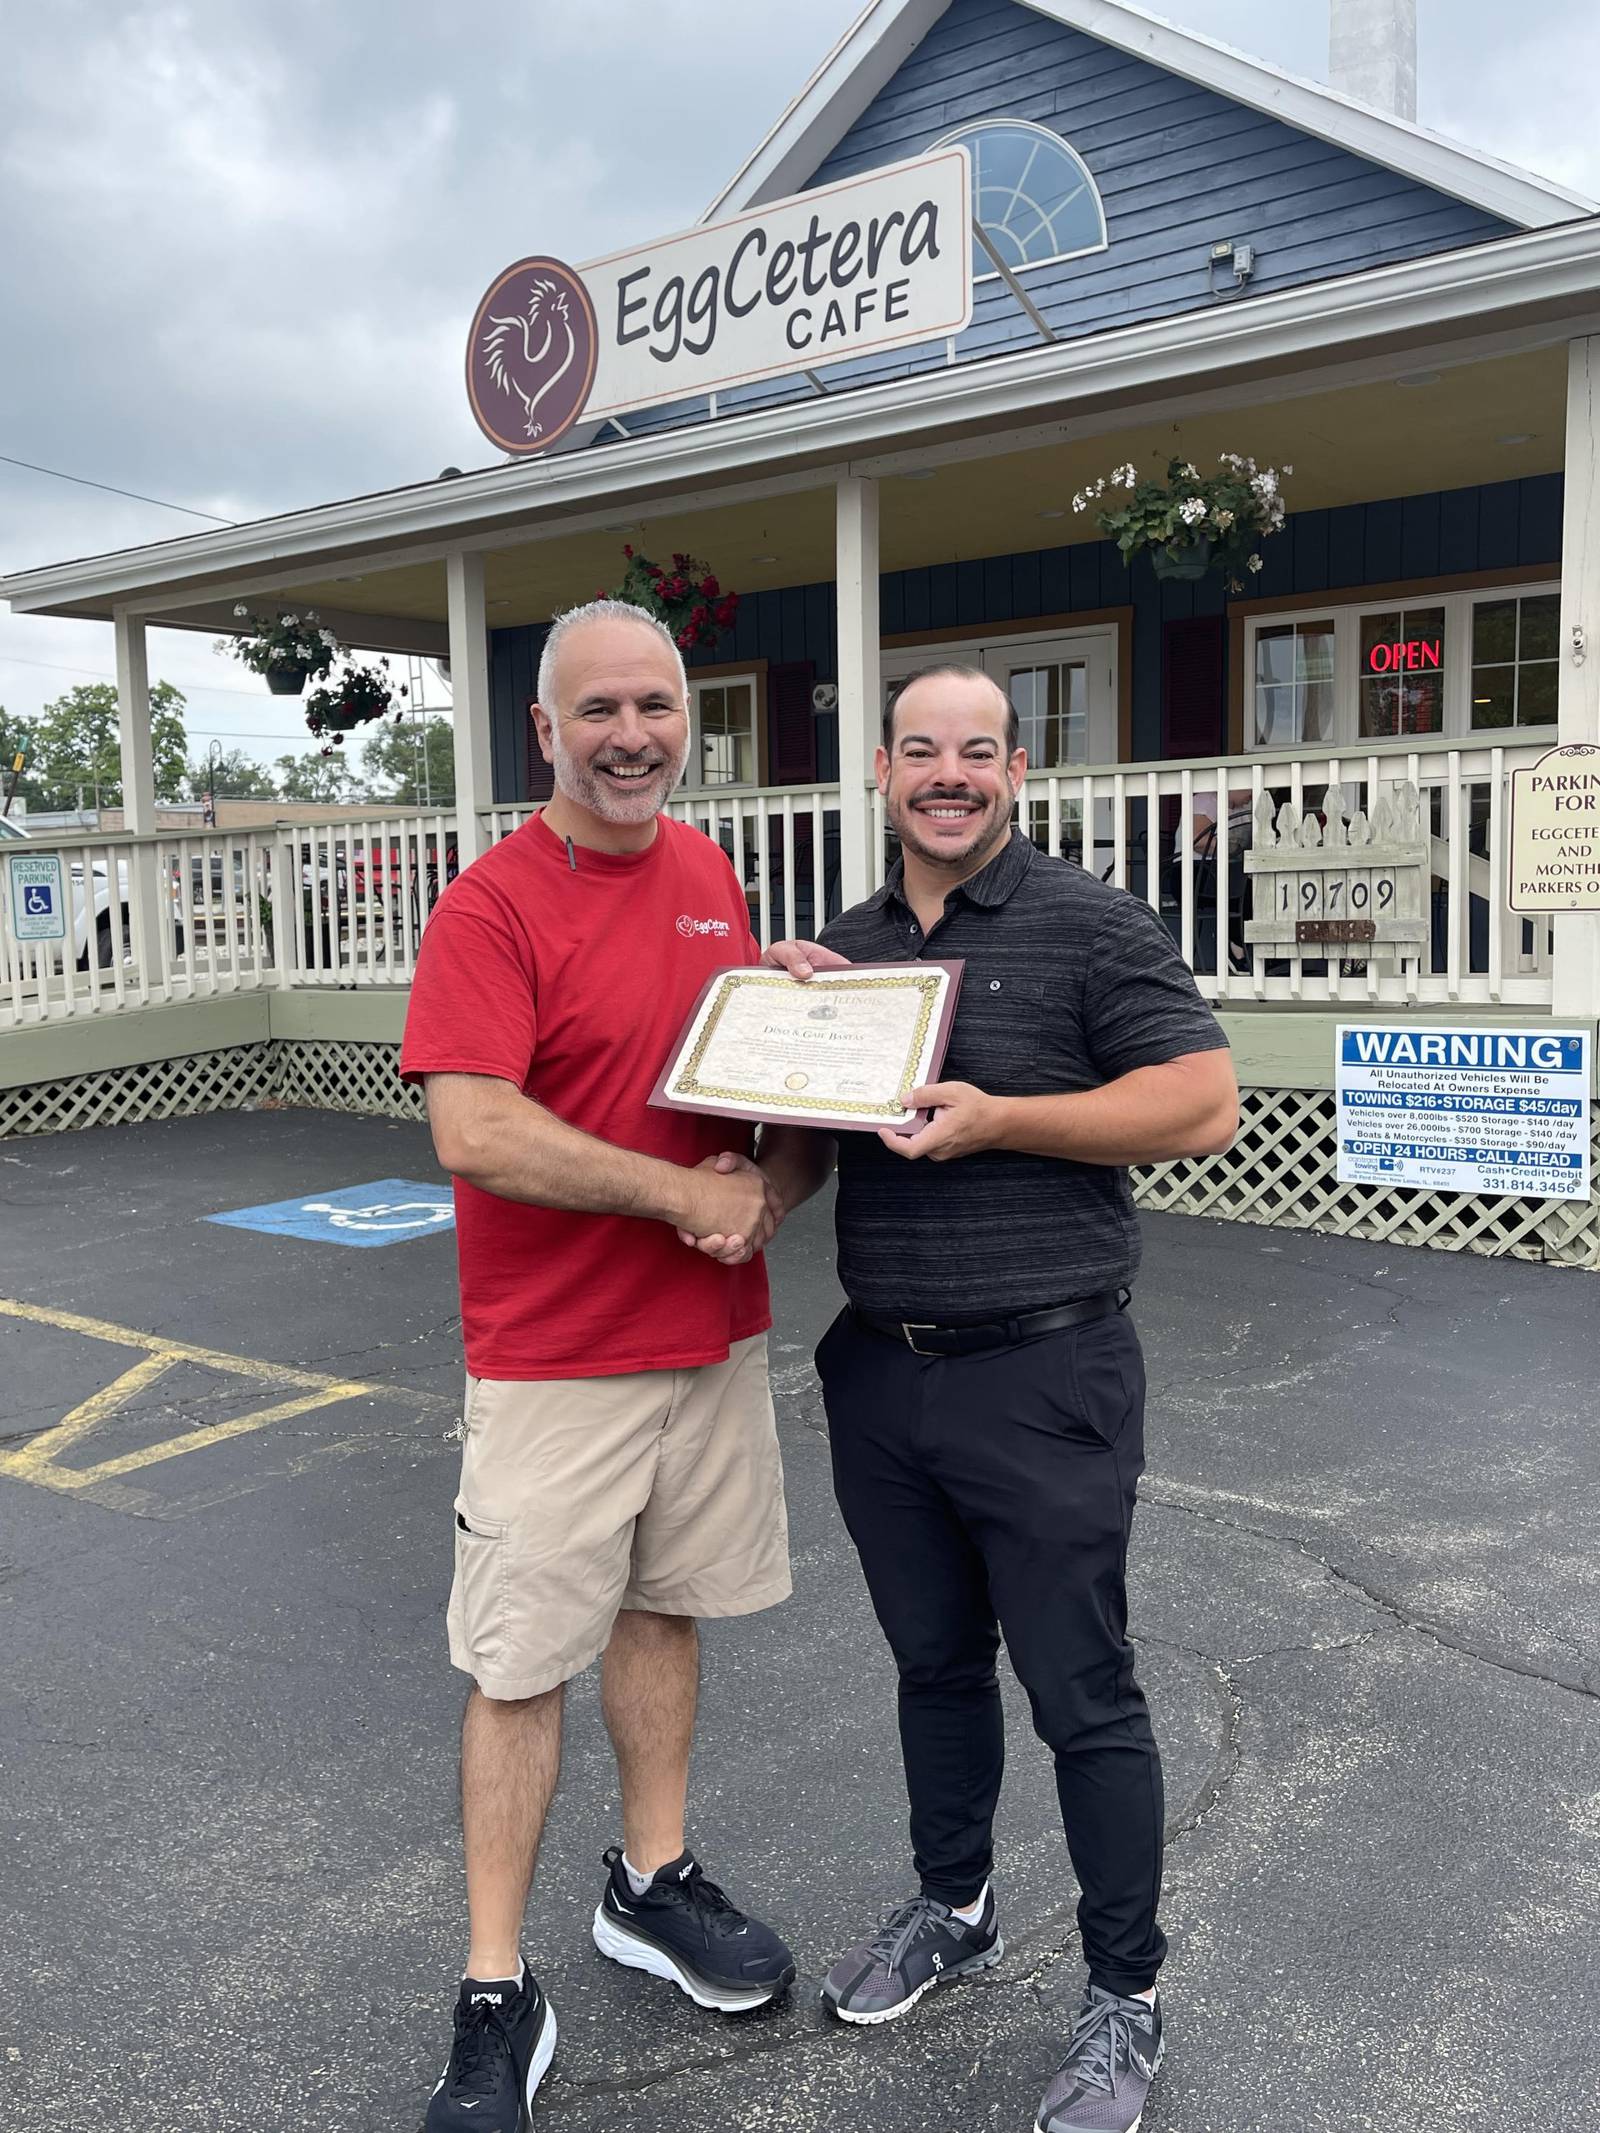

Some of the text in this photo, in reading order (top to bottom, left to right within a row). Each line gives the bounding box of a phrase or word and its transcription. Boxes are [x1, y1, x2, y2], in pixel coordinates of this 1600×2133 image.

[616, 200, 940, 363] EggCetera
[786, 278, 910, 350] CAFE
[1370, 640, 1439, 672] OPEN
[1555, 795, 1596, 811] FOR
[1532, 827, 1598, 840] EGGCETE
[1557, 846, 1592, 857] AND
[14, 861, 56, 872] RESERVED
[18, 874, 54, 884] PARKING
[1520, 882, 1582, 894] PARKERS
[1282, 879, 1394, 912] 19709
[1356, 1032, 1562, 1068] WARNING
[1370, 1070, 1549, 1084] All Unauthorized Vehicles Will Be
[1378, 1081, 1540, 1096] Relocated At Owners Expense
[1346, 1092, 1402, 1105] TOWING
[1519, 1100, 1578, 1116] $45/day
[1349, 1109, 1385, 1118] Vehicles
[1456, 1115, 1478, 1123] $520
[1481, 1116, 1519, 1126] Storage
[1553, 1120, 1574, 1129] /day
[1347, 1119, 1382, 1128] Vehicles
[1458, 1126, 1481, 1134] $700
[1484, 1127, 1521, 1138] Storage
[1530, 1130, 1552, 1138] $140
[1556, 1131, 1577, 1140] /day
[1357, 1131, 1381, 1139] Boats
[1394, 1133, 1447, 1143] Motorcycles
[1455, 1137, 1477, 1145] $350
[1480, 1138, 1518, 1148] Storage
[1526, 1141, 1566, 1151] $90/day
[1353, 1142, 1391, 1155] OPEN
[1395, 1145, 1411, 1156] 24
[1517, 1153, 1570, 1166] AHEAD
[1355, 1163, 1378, 1172] towing
[1483, 1178, 1575, 1193] 331.814.3456
